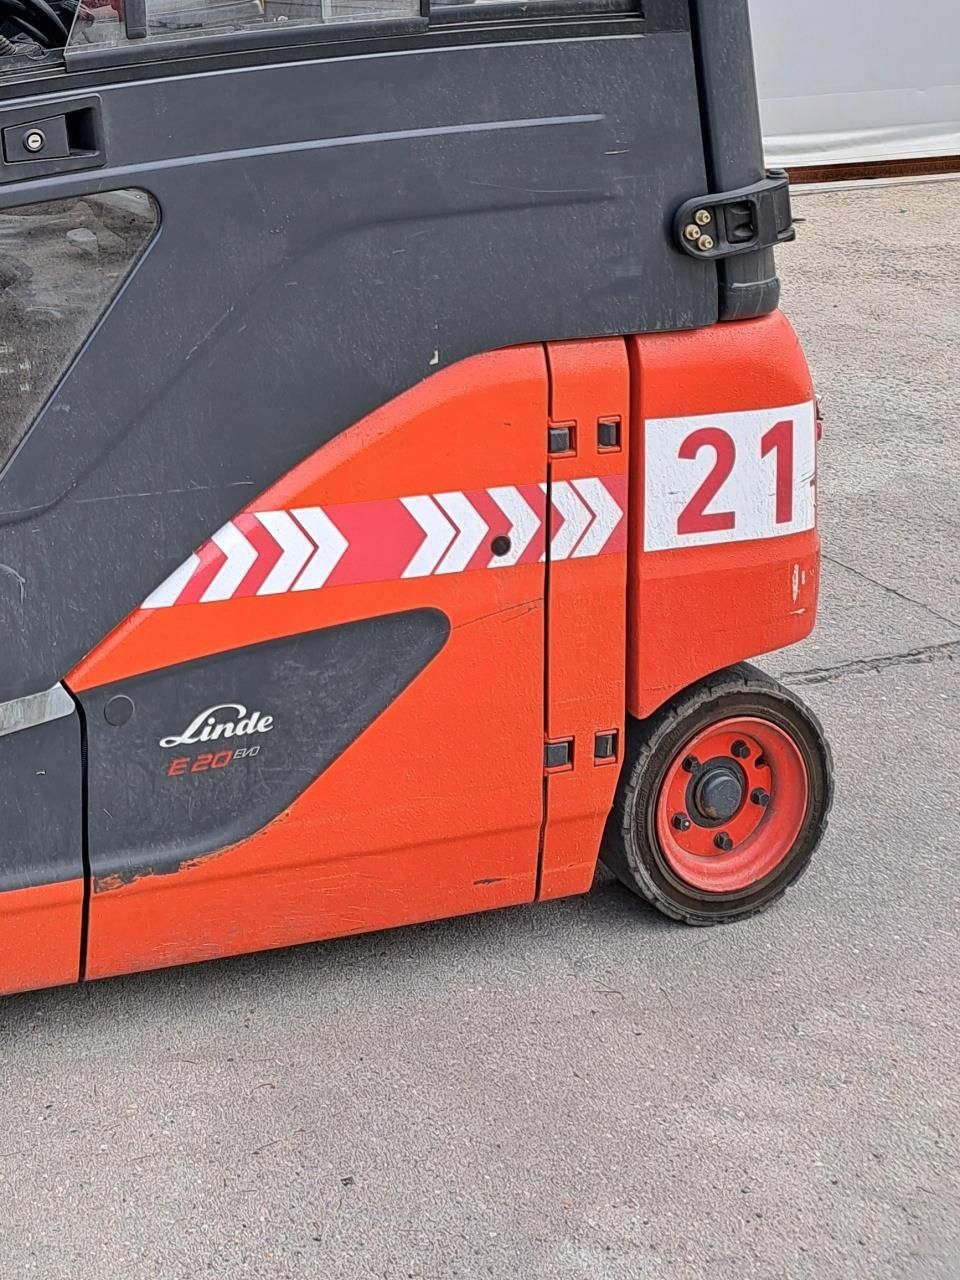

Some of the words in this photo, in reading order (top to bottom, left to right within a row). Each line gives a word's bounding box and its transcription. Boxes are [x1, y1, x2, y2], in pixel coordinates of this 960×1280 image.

[677, 420, 794, 536] 21
[159, 703, 274, 748] Linde
[233, 746, 260, 759] EVO
